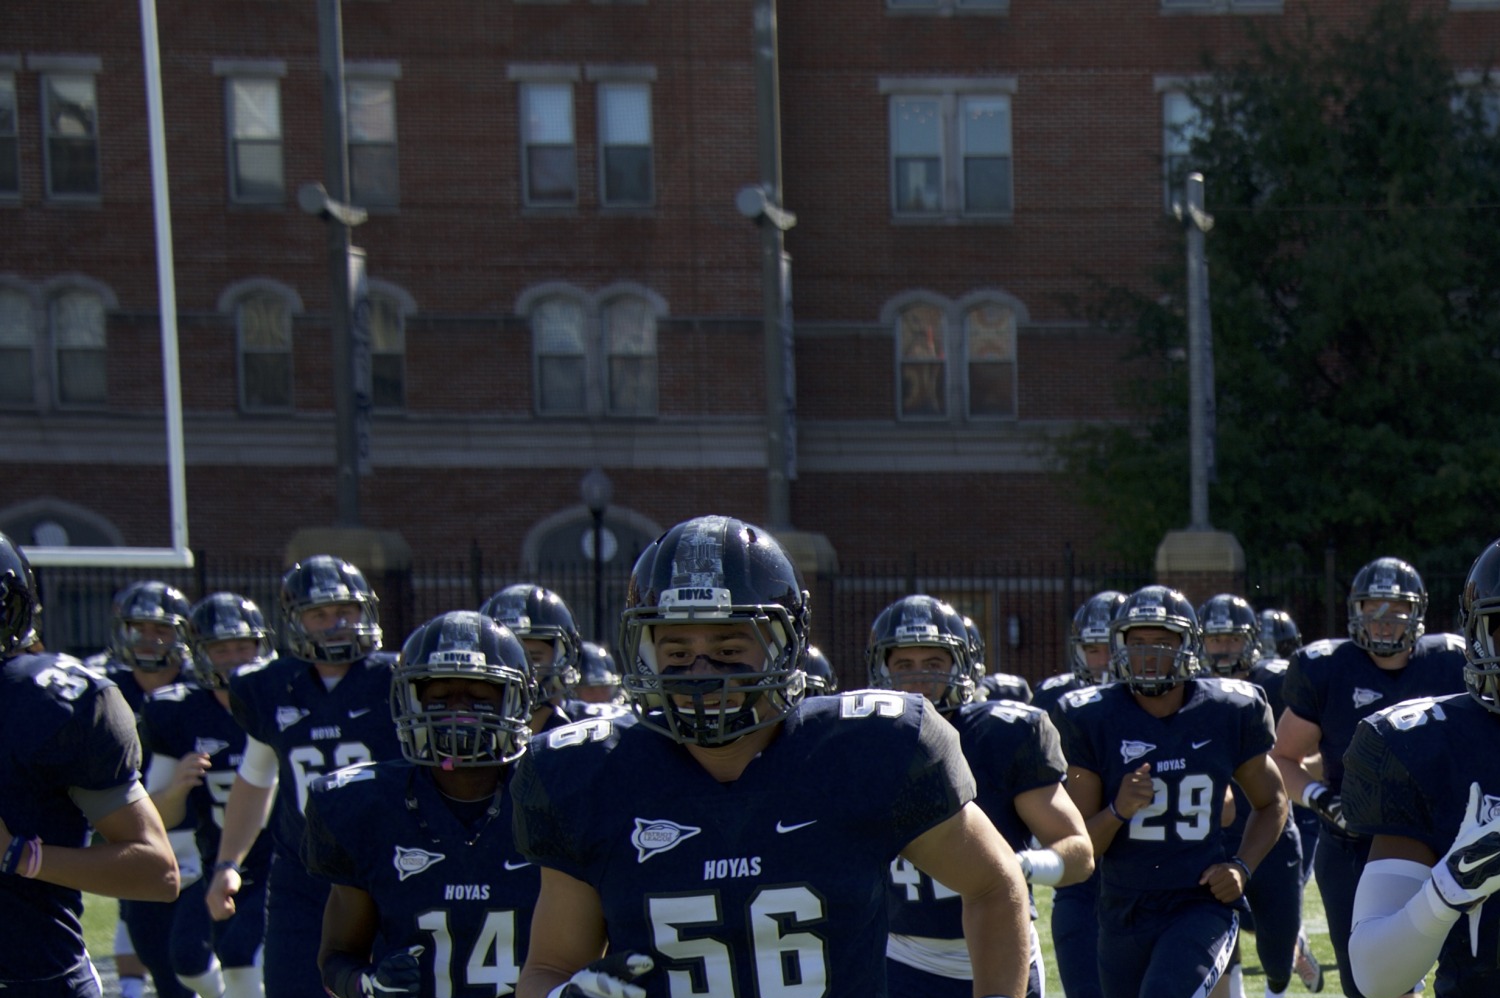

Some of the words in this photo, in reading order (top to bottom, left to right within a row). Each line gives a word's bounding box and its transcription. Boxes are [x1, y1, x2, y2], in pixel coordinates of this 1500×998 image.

[677, 588, 714, 601] HOYAS
[443, 652, 472, 663] HOYAS
[310, 726, 342, 741] HOYAS
[1157, 758, 1187, 773] HOYAS
[1129, 774, 1214, 841] 29
[703, 856, 762, 880] HOYAS
[889, 853, 961, 901] 4
[444, 884, 491, 900] HOYAS
